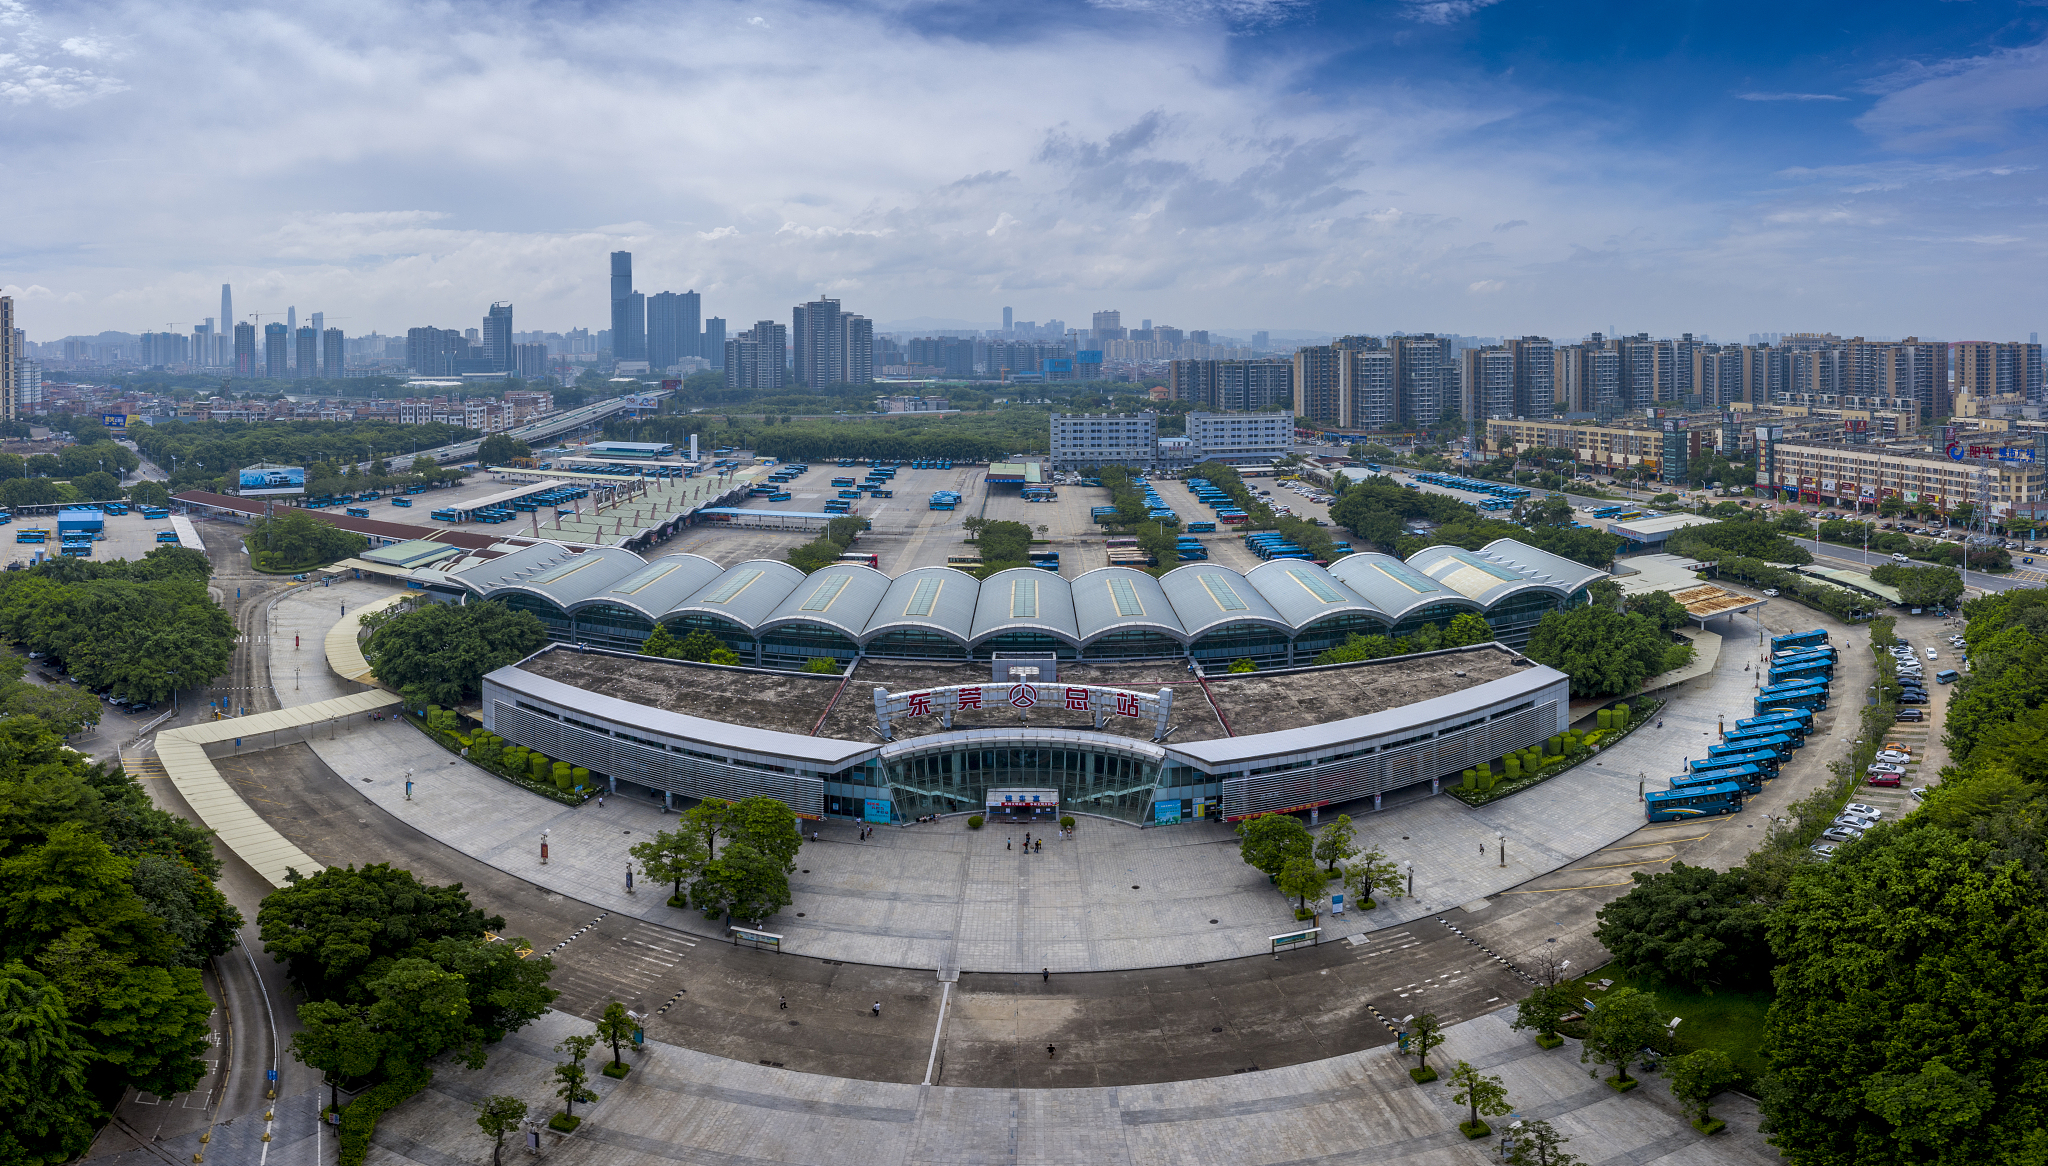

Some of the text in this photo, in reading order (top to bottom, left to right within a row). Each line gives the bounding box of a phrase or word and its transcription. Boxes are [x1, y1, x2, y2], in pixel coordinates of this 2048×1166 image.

[1970, 445, 1994, 460] 阳光
[907, 686, 1140, 719] 东莞 总站
